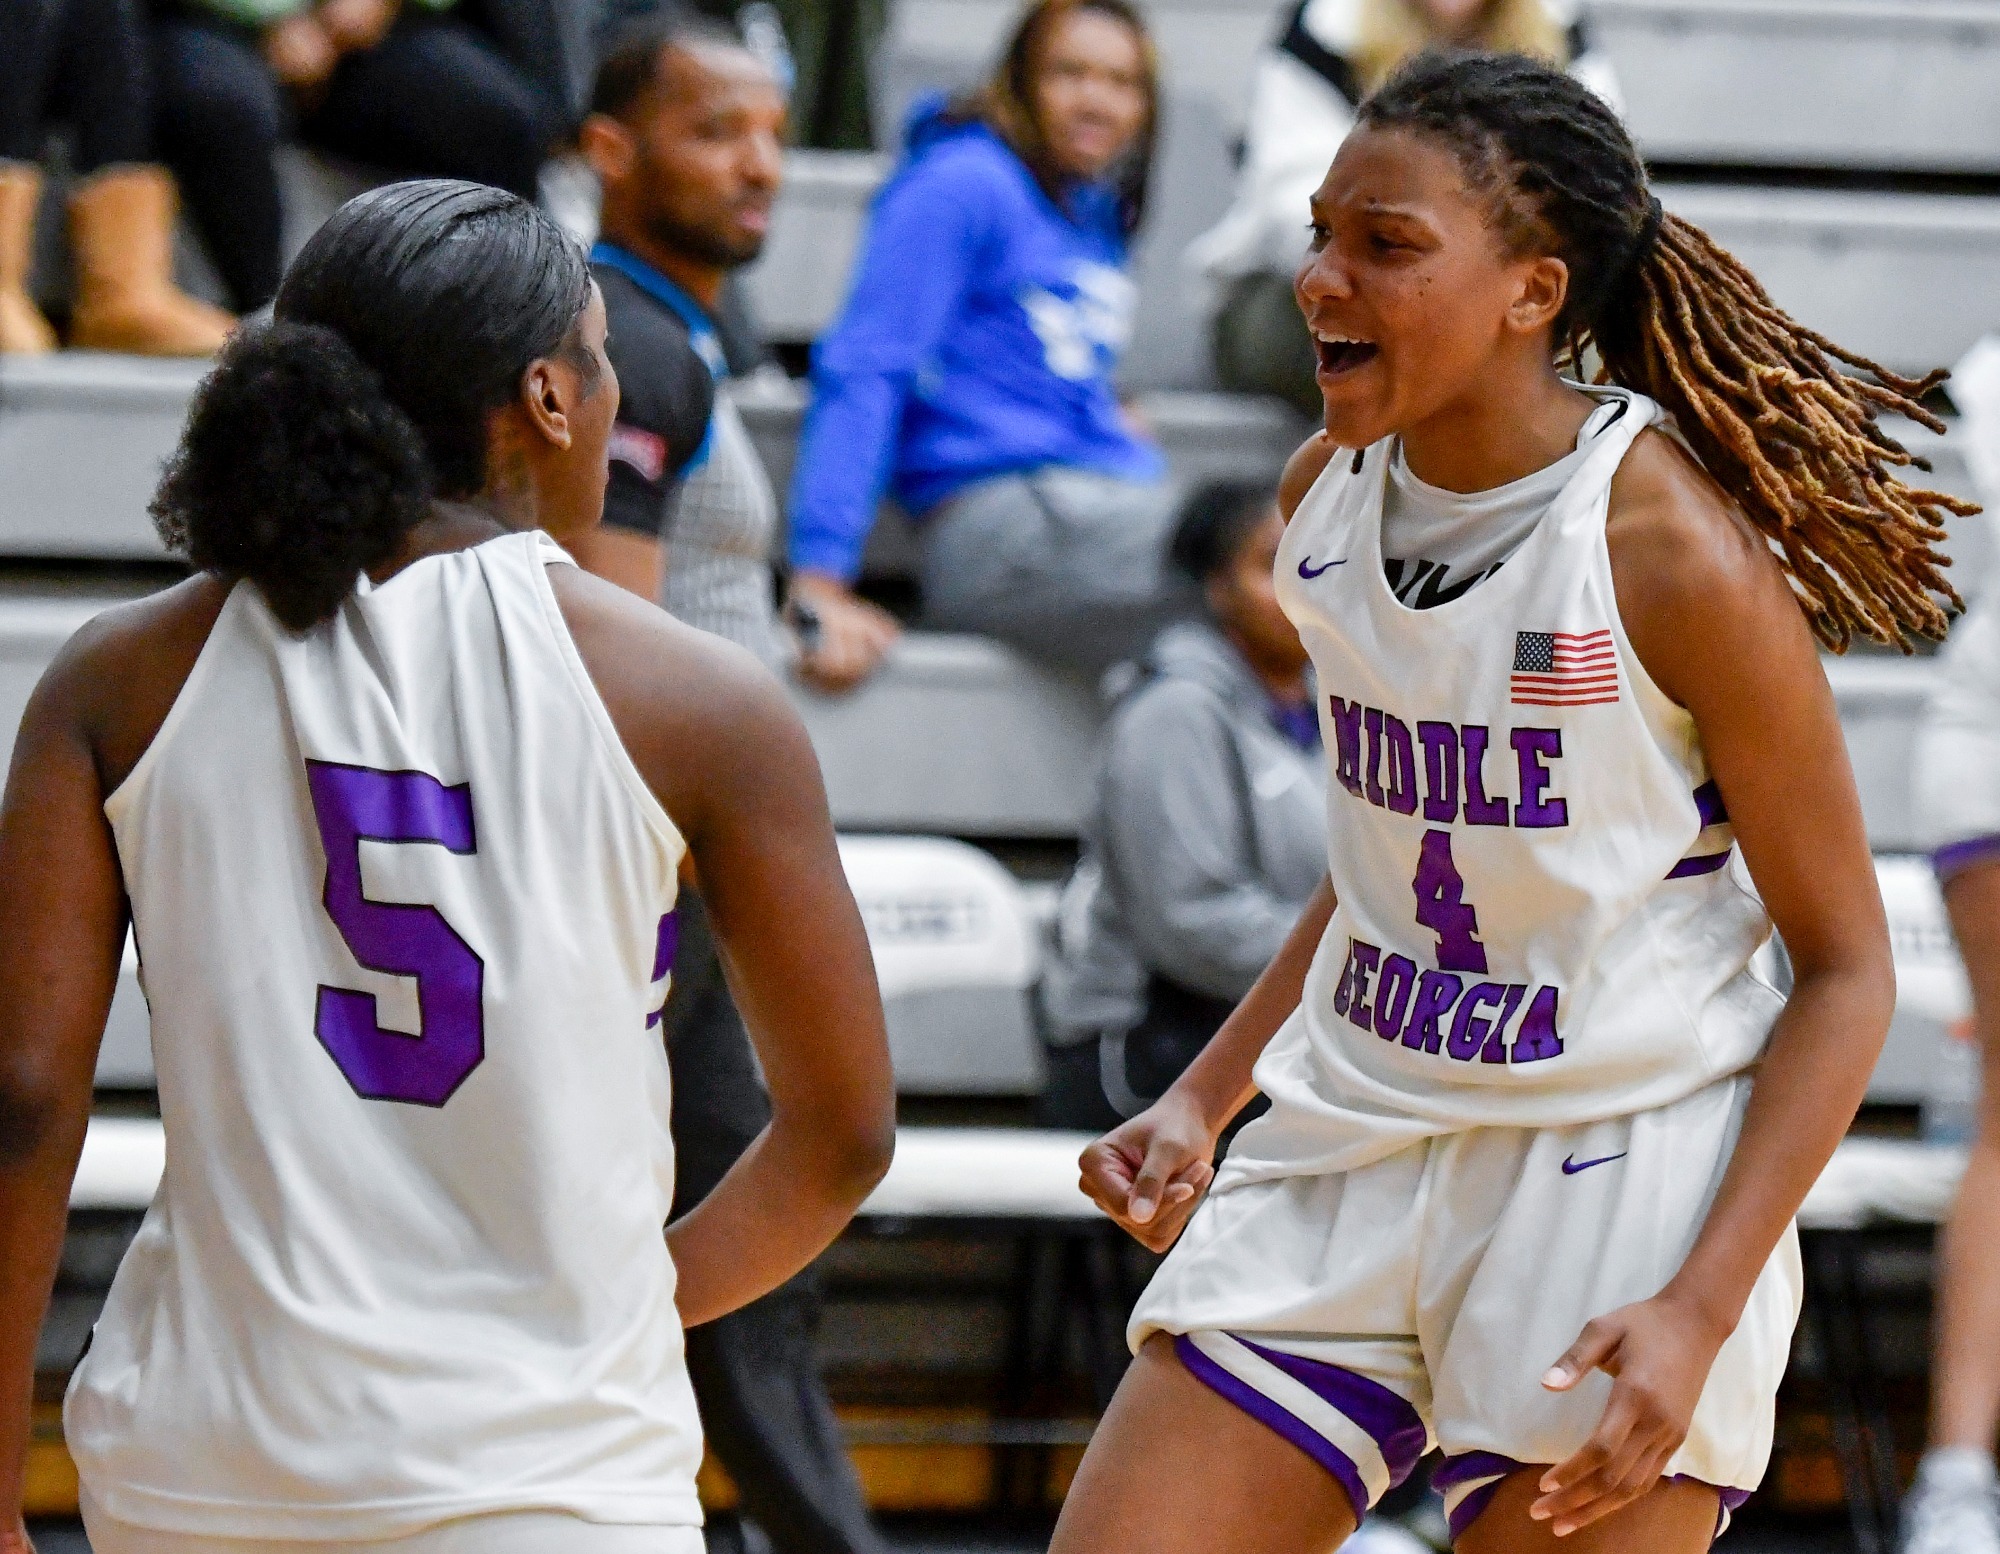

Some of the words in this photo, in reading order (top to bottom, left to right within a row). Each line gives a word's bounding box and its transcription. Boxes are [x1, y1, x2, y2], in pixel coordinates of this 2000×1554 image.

[1330, 694, 1569, 828] MIDDLE
[304, 757, 486, 1109] 5
[1412, 828, 1489, 975] 4
